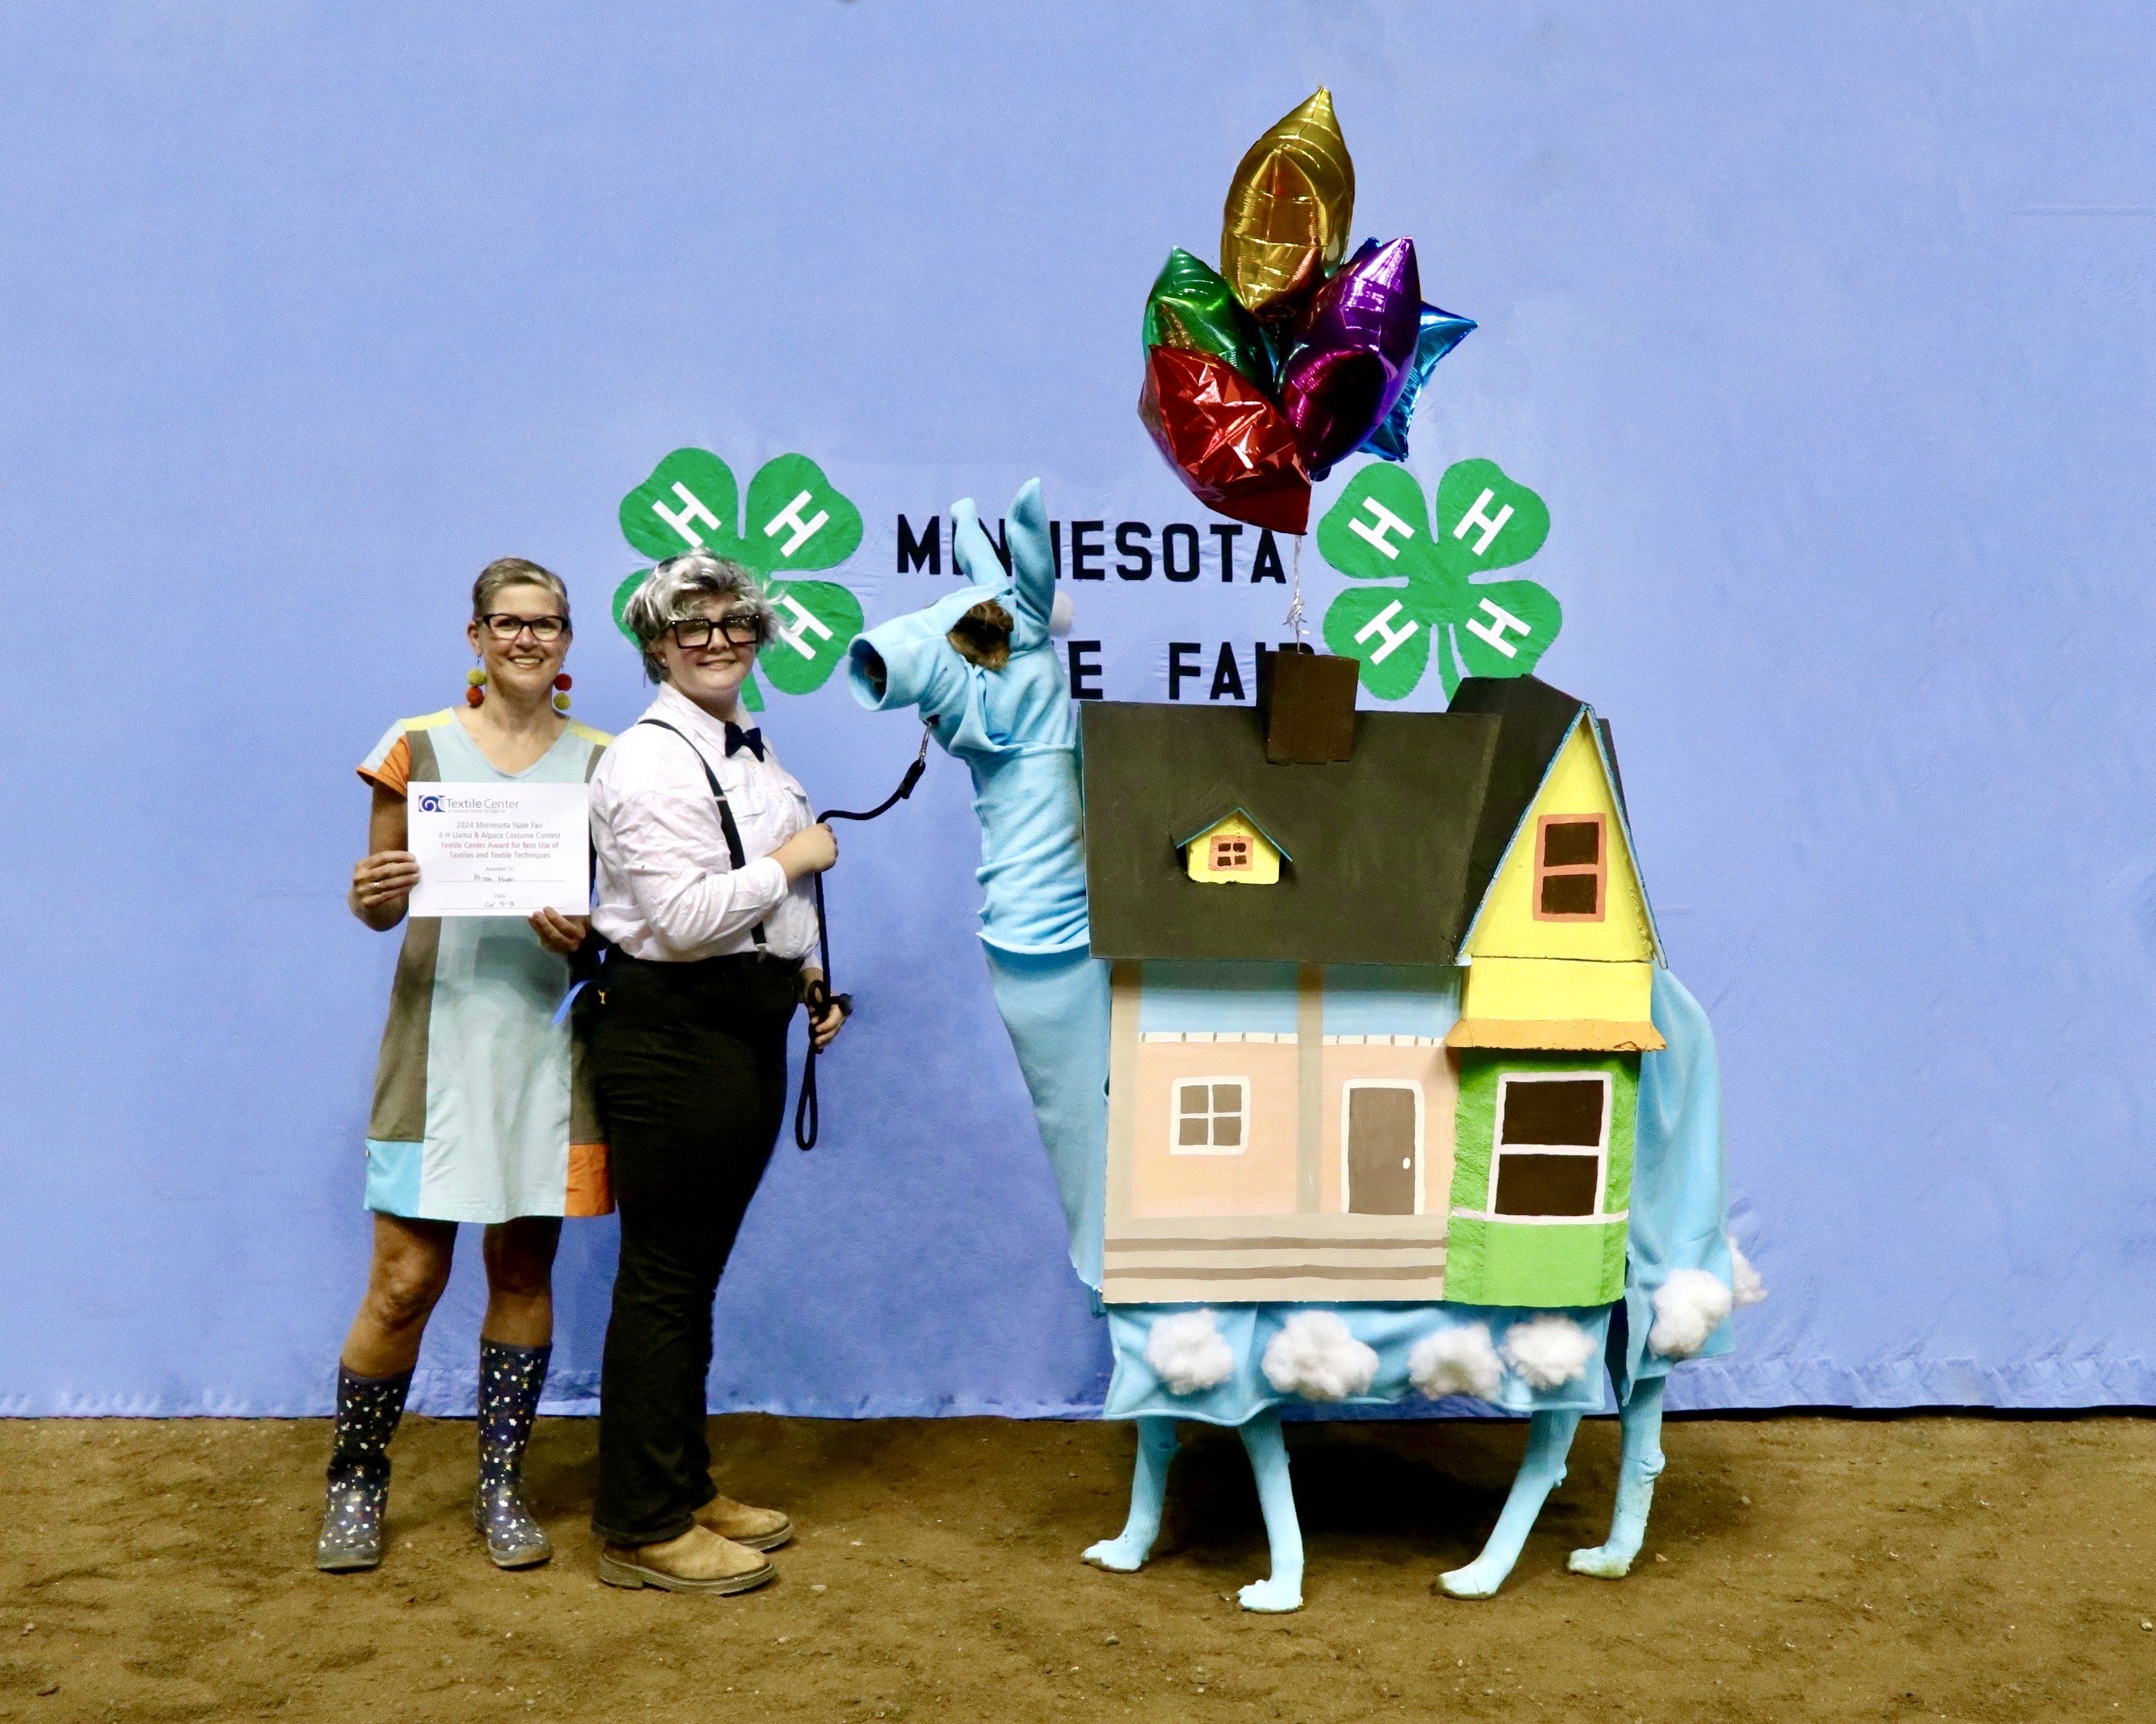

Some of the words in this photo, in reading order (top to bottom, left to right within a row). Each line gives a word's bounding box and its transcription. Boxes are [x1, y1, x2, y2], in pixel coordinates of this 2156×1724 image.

[652, 481, 721, 547] H
[764, 490, 830, 557] H
[1348, 496, 1414, 560] H
[1453, 487, 1514, 556] H
[778, 595, 833, 660] H
[1354, 599, 1419, 665] H
[1465, 597, 1531, 658] H
[1169, 641, 1314, 700] FA
[446, 798, 482, 809] Textile
[484, 798, 519, 809] Center
[457, 821, 474, 829] 2024
[476, 821, 511, 829] Minnesota
[512, 821, 529, 829] State
[531, 821, 543, 829] Fair
[448, 851, 474, 859] Textiles
[475, 851, 489, 859] and
[491, 851, 512, 859] Textile
[514, 851, 551, 860] Techniques
[481, 831, 503, 839] Alpaca
[538, 841, 550, 849] Use
[552, 841, 559, 849] of
